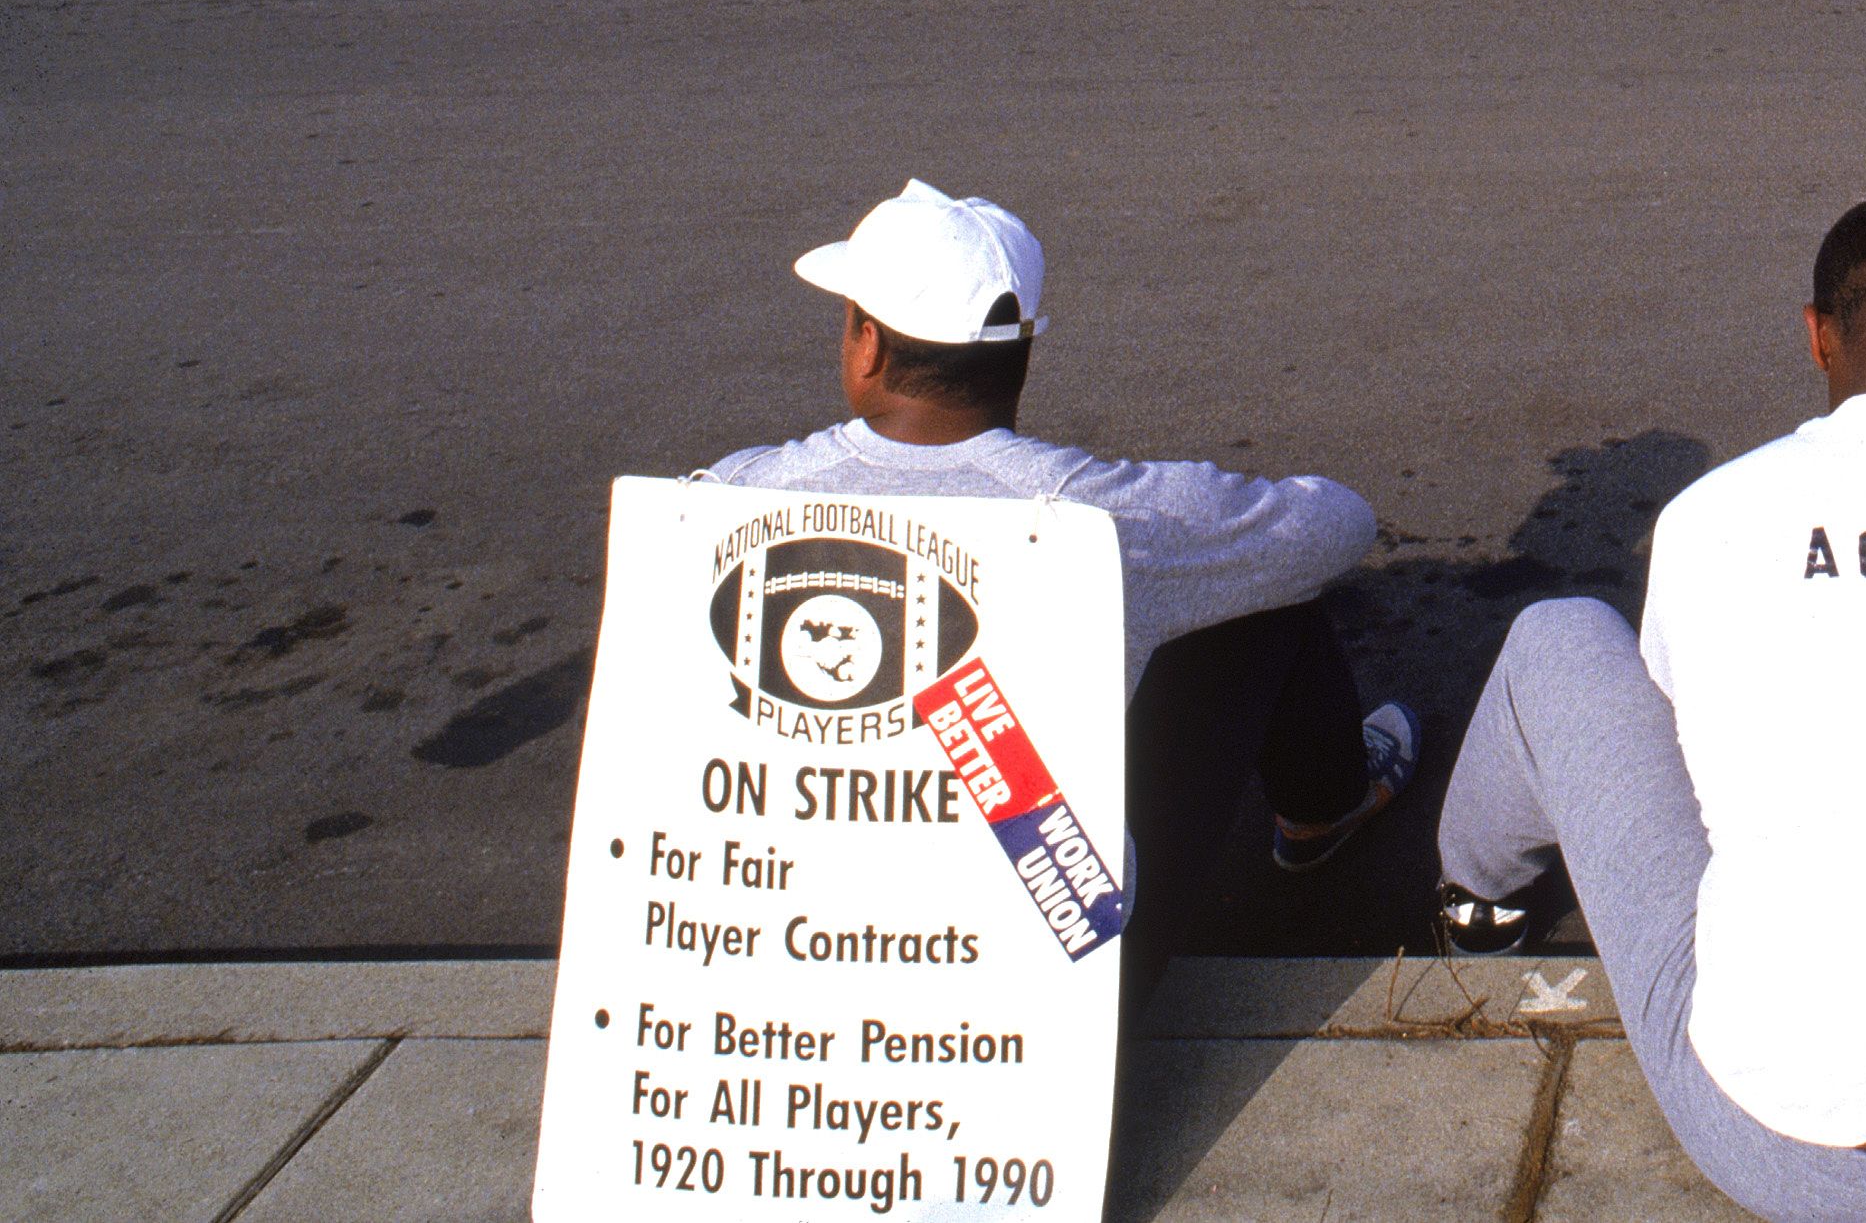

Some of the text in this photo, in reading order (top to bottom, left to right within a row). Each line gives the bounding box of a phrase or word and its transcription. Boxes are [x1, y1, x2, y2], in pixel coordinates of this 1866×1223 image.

[712, 503, 979, 605] NATIONAL FOOTBALL LEAGUE
[757, 695, 906, 745] PLAYERS
[953, 668, 1015, 742] LIVE
[702, 758, 961, 823] ON STRIKE
[928, 700, 1011, 815] BETTER
[650, 832, 794, 890] For Fair
[1039, 805, 1114, 908] WORK
[645, 901, 979, 967] Player Contracts
[1017, 846, 1098, 954] UNION
[637, 1003, 1024, 1064] For Better Pension
[633, 1070, 960, 1144] For All Players,
[633, 1140, 1054, 1214] 1920 Through 1990
